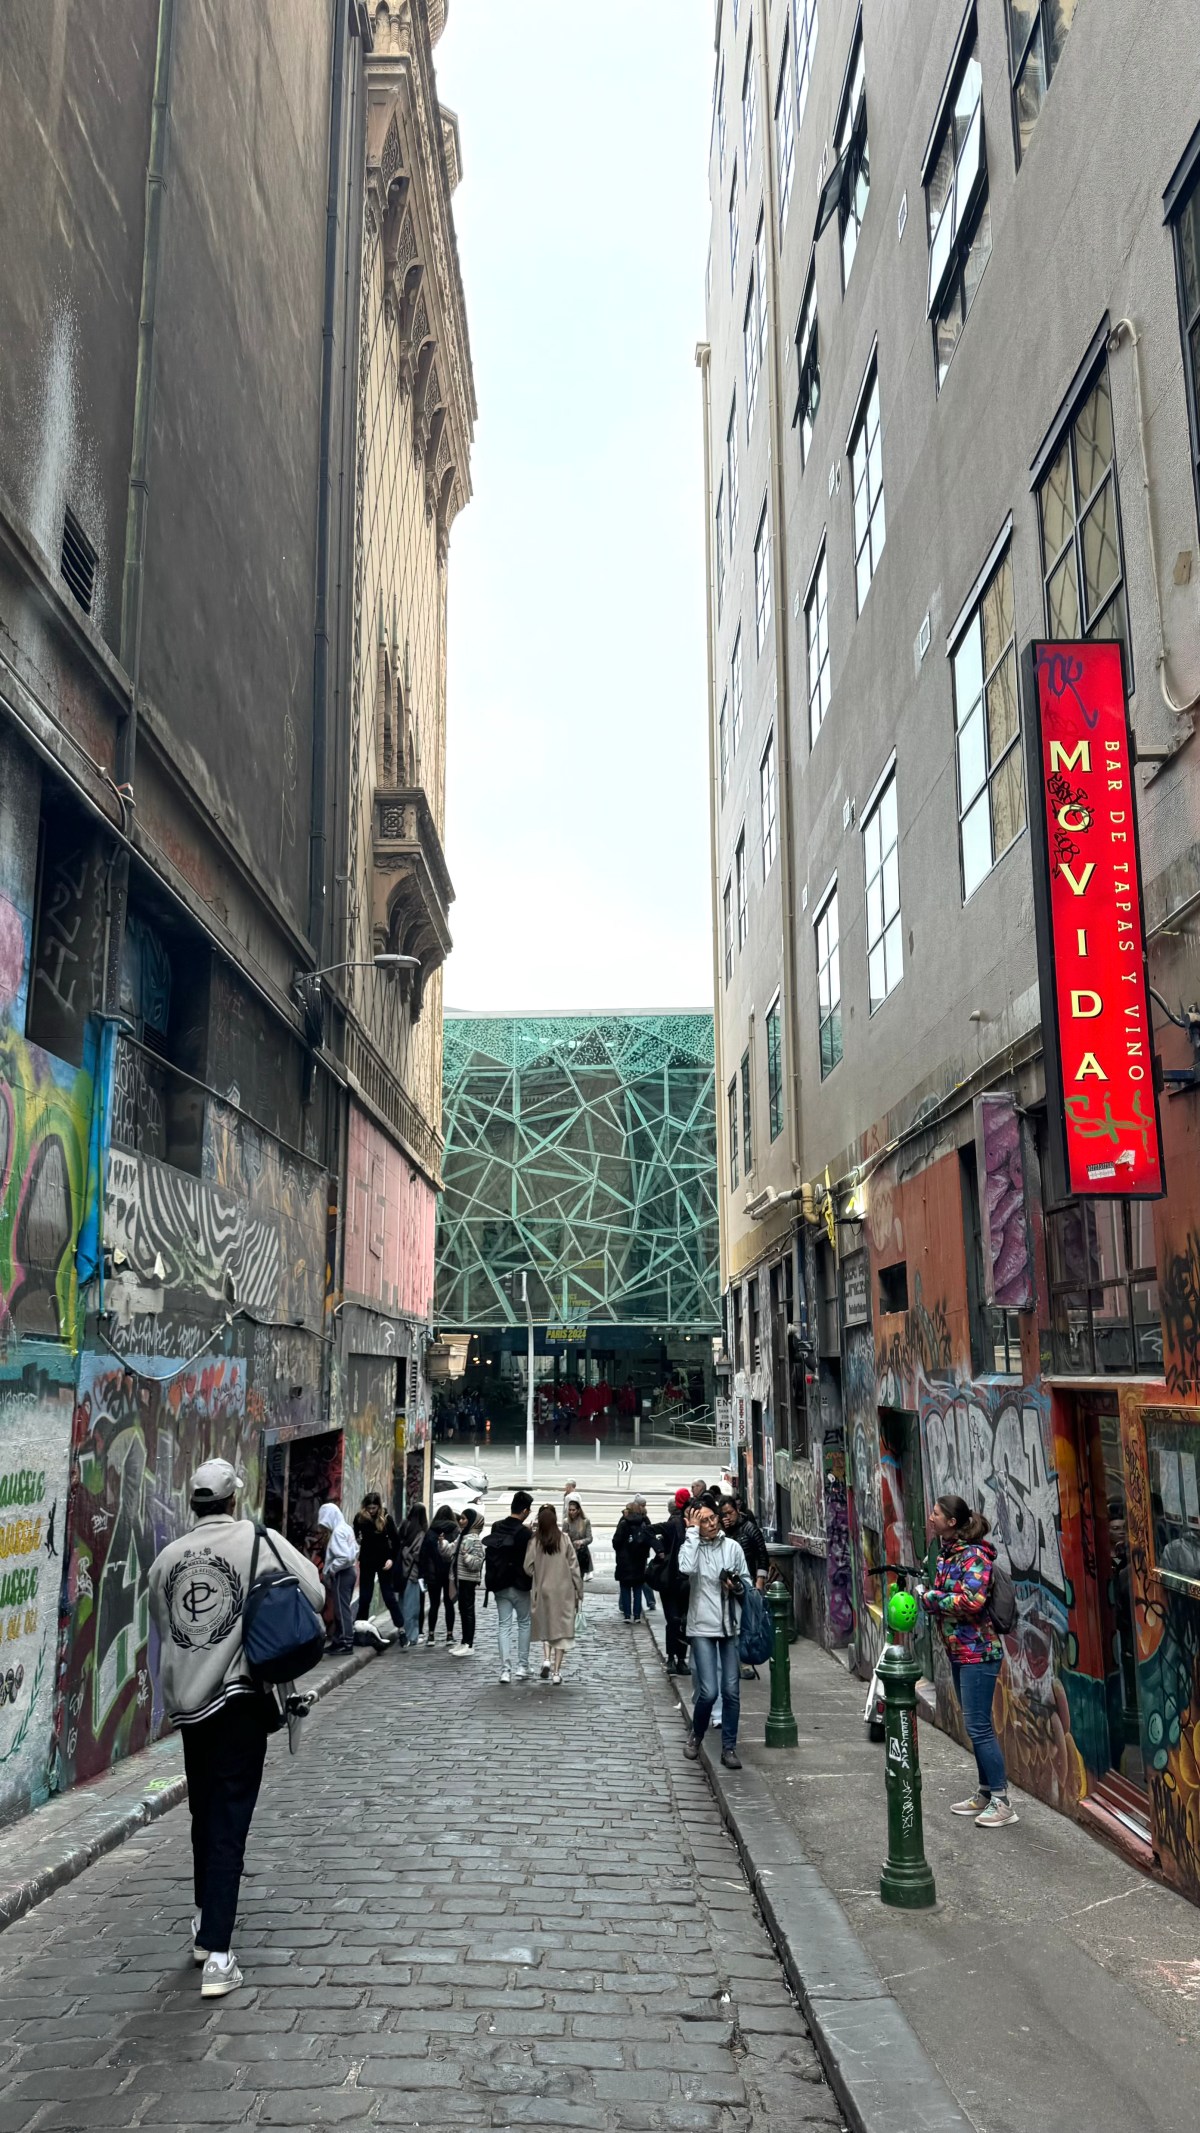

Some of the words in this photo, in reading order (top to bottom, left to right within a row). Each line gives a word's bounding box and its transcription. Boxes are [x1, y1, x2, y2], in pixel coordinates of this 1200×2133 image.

[1104, 741, 1123, 790] BAR
[1110, 811, 1127, 843] DE
[1049, 740, 1109, 1081] MOVIDA
[1113, 862, 1136, 952] TAPAS
[1121, 971, 1137, 984] Y
[1124, 1004, 1145, 1081] VINO
[0, 1566, 39, 1608] ussie
